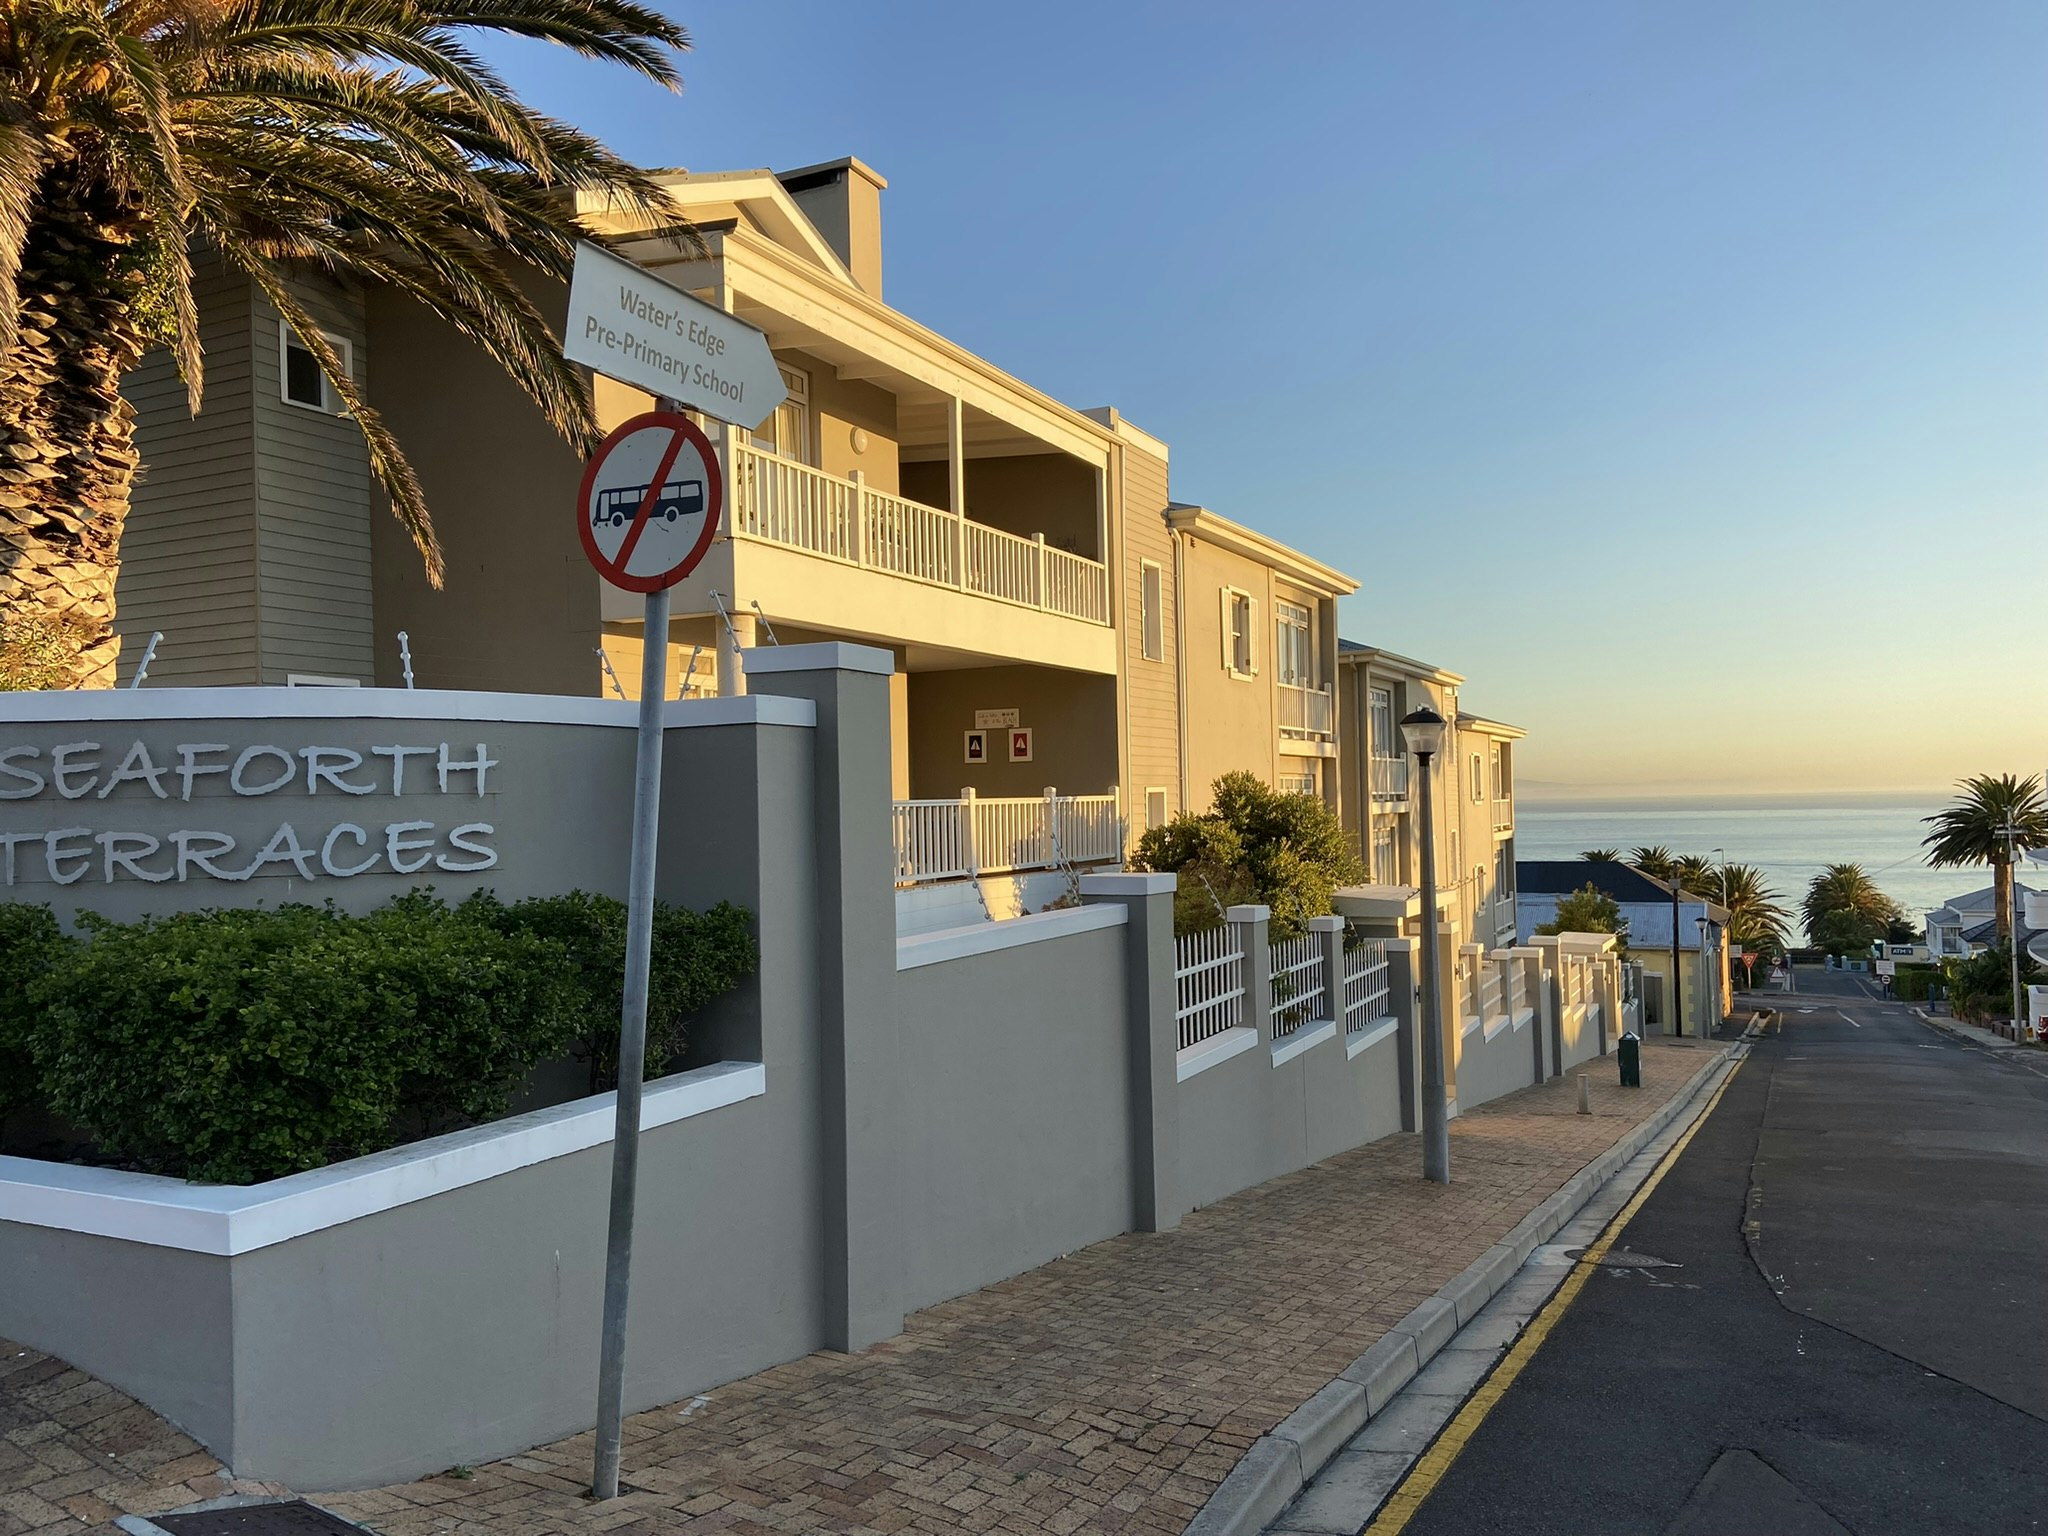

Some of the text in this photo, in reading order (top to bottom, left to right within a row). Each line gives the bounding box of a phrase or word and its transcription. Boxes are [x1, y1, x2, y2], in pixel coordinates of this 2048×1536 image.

[619, 285, 726, 356] Water's Edge
[585, 315, 744, 403] Pre-Primary School
[0, 739, 499, 801] SEAFORTH
[0, 822, 499, 886] TERRACES
